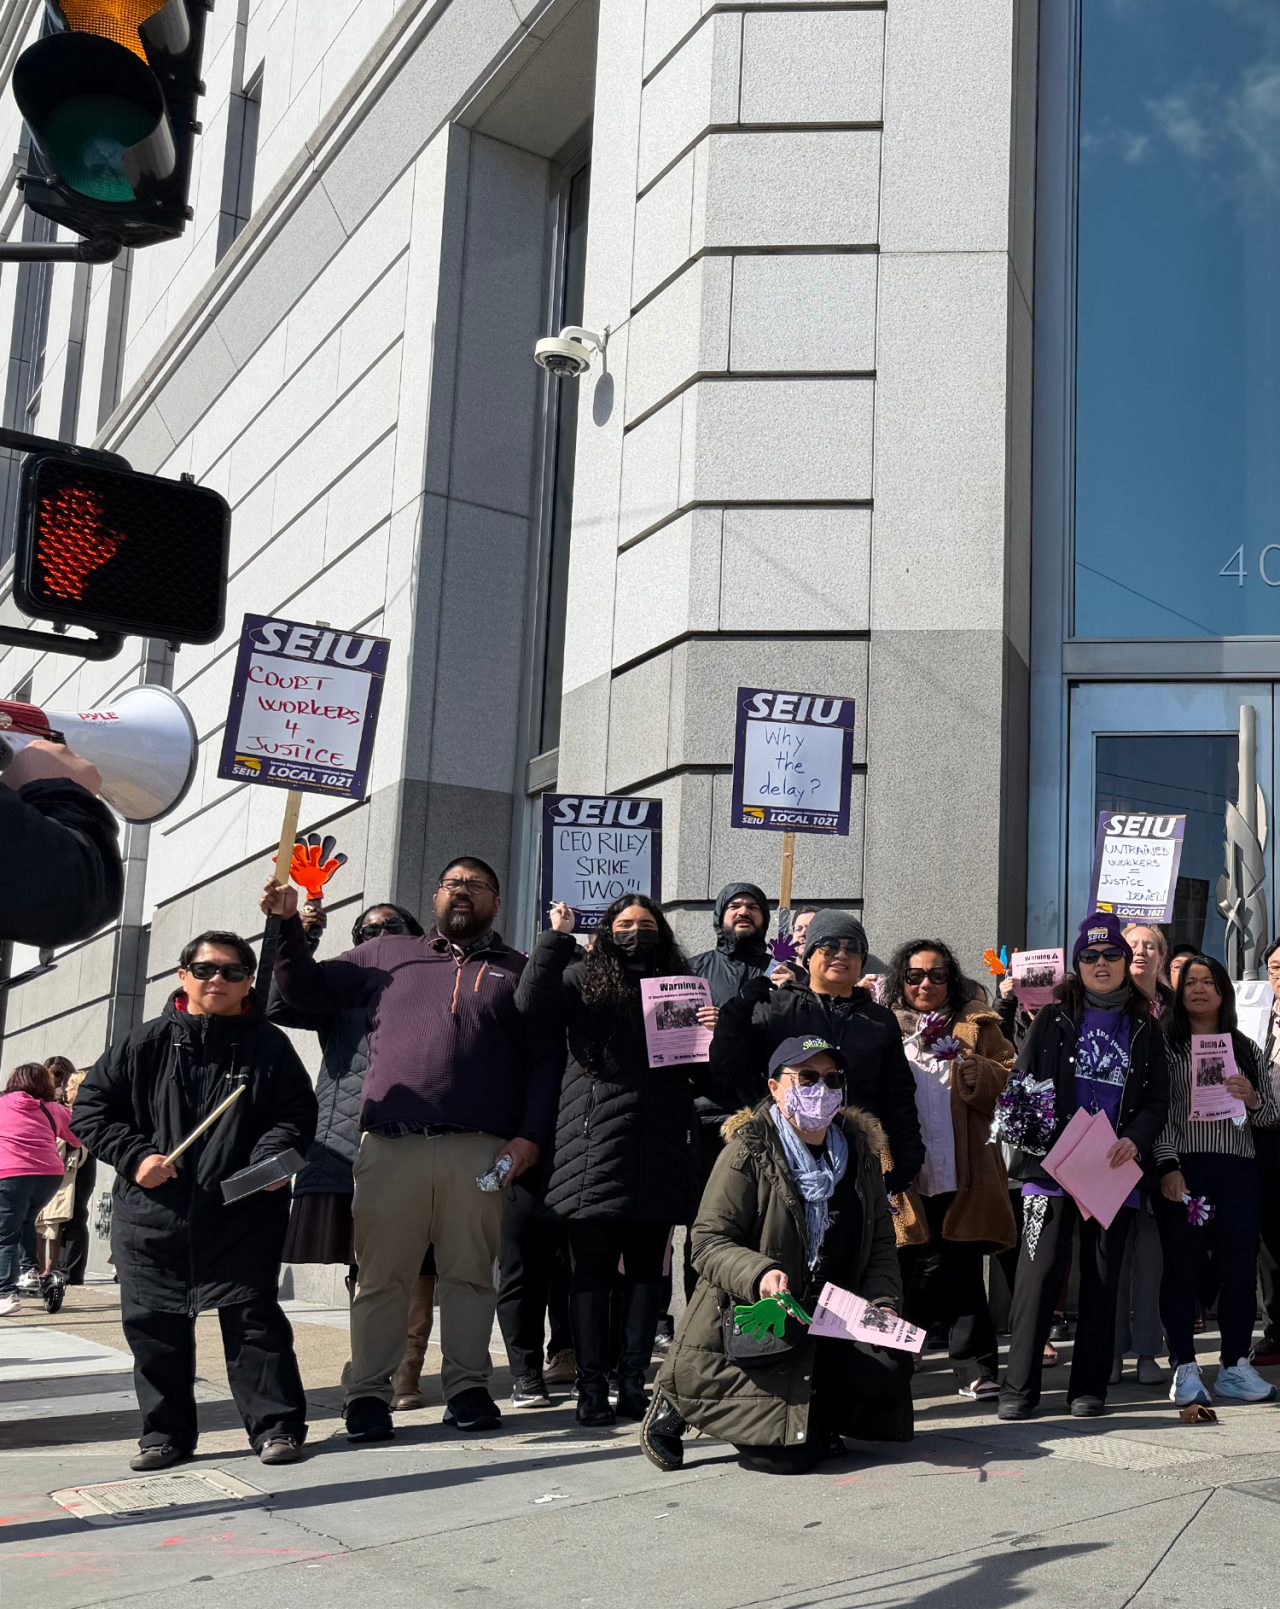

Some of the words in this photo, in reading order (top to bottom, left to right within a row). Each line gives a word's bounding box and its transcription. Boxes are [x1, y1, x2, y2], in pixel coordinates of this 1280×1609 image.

[254, 621, 376, 667] SEIU
[248, 665, 335, 691] COURT
[78, 711, 120, 721] PYLE
[258, 696, 360, 725] WORKERS
[747, 692, 844, 724] SEIU
[285, 719, 301, 739] 4
[764, 725, 805, 757] Why
[232, 766, 260, 778] SEIU
[775, 751, 805, 774] the
[267, 765, 318, 783] LOCAL
[321, 773, 353, 788] 1021
[759, 771, 821, 806] delay?
[553, 797, 650, 826] SEIU
[741, 815, 764, 825] SEIU
[770, 813, 810, 824] LOCAL
[813, 816, 838, 826] 1021
[1106, 815, 1177, 838] SEIU
[560, 829, 592, 852] CEO
[575, 856, 631, 877] STRIKE
[1116, 907, 1145, 917] LOCAL
[659, 981, 697, 992] Warning
